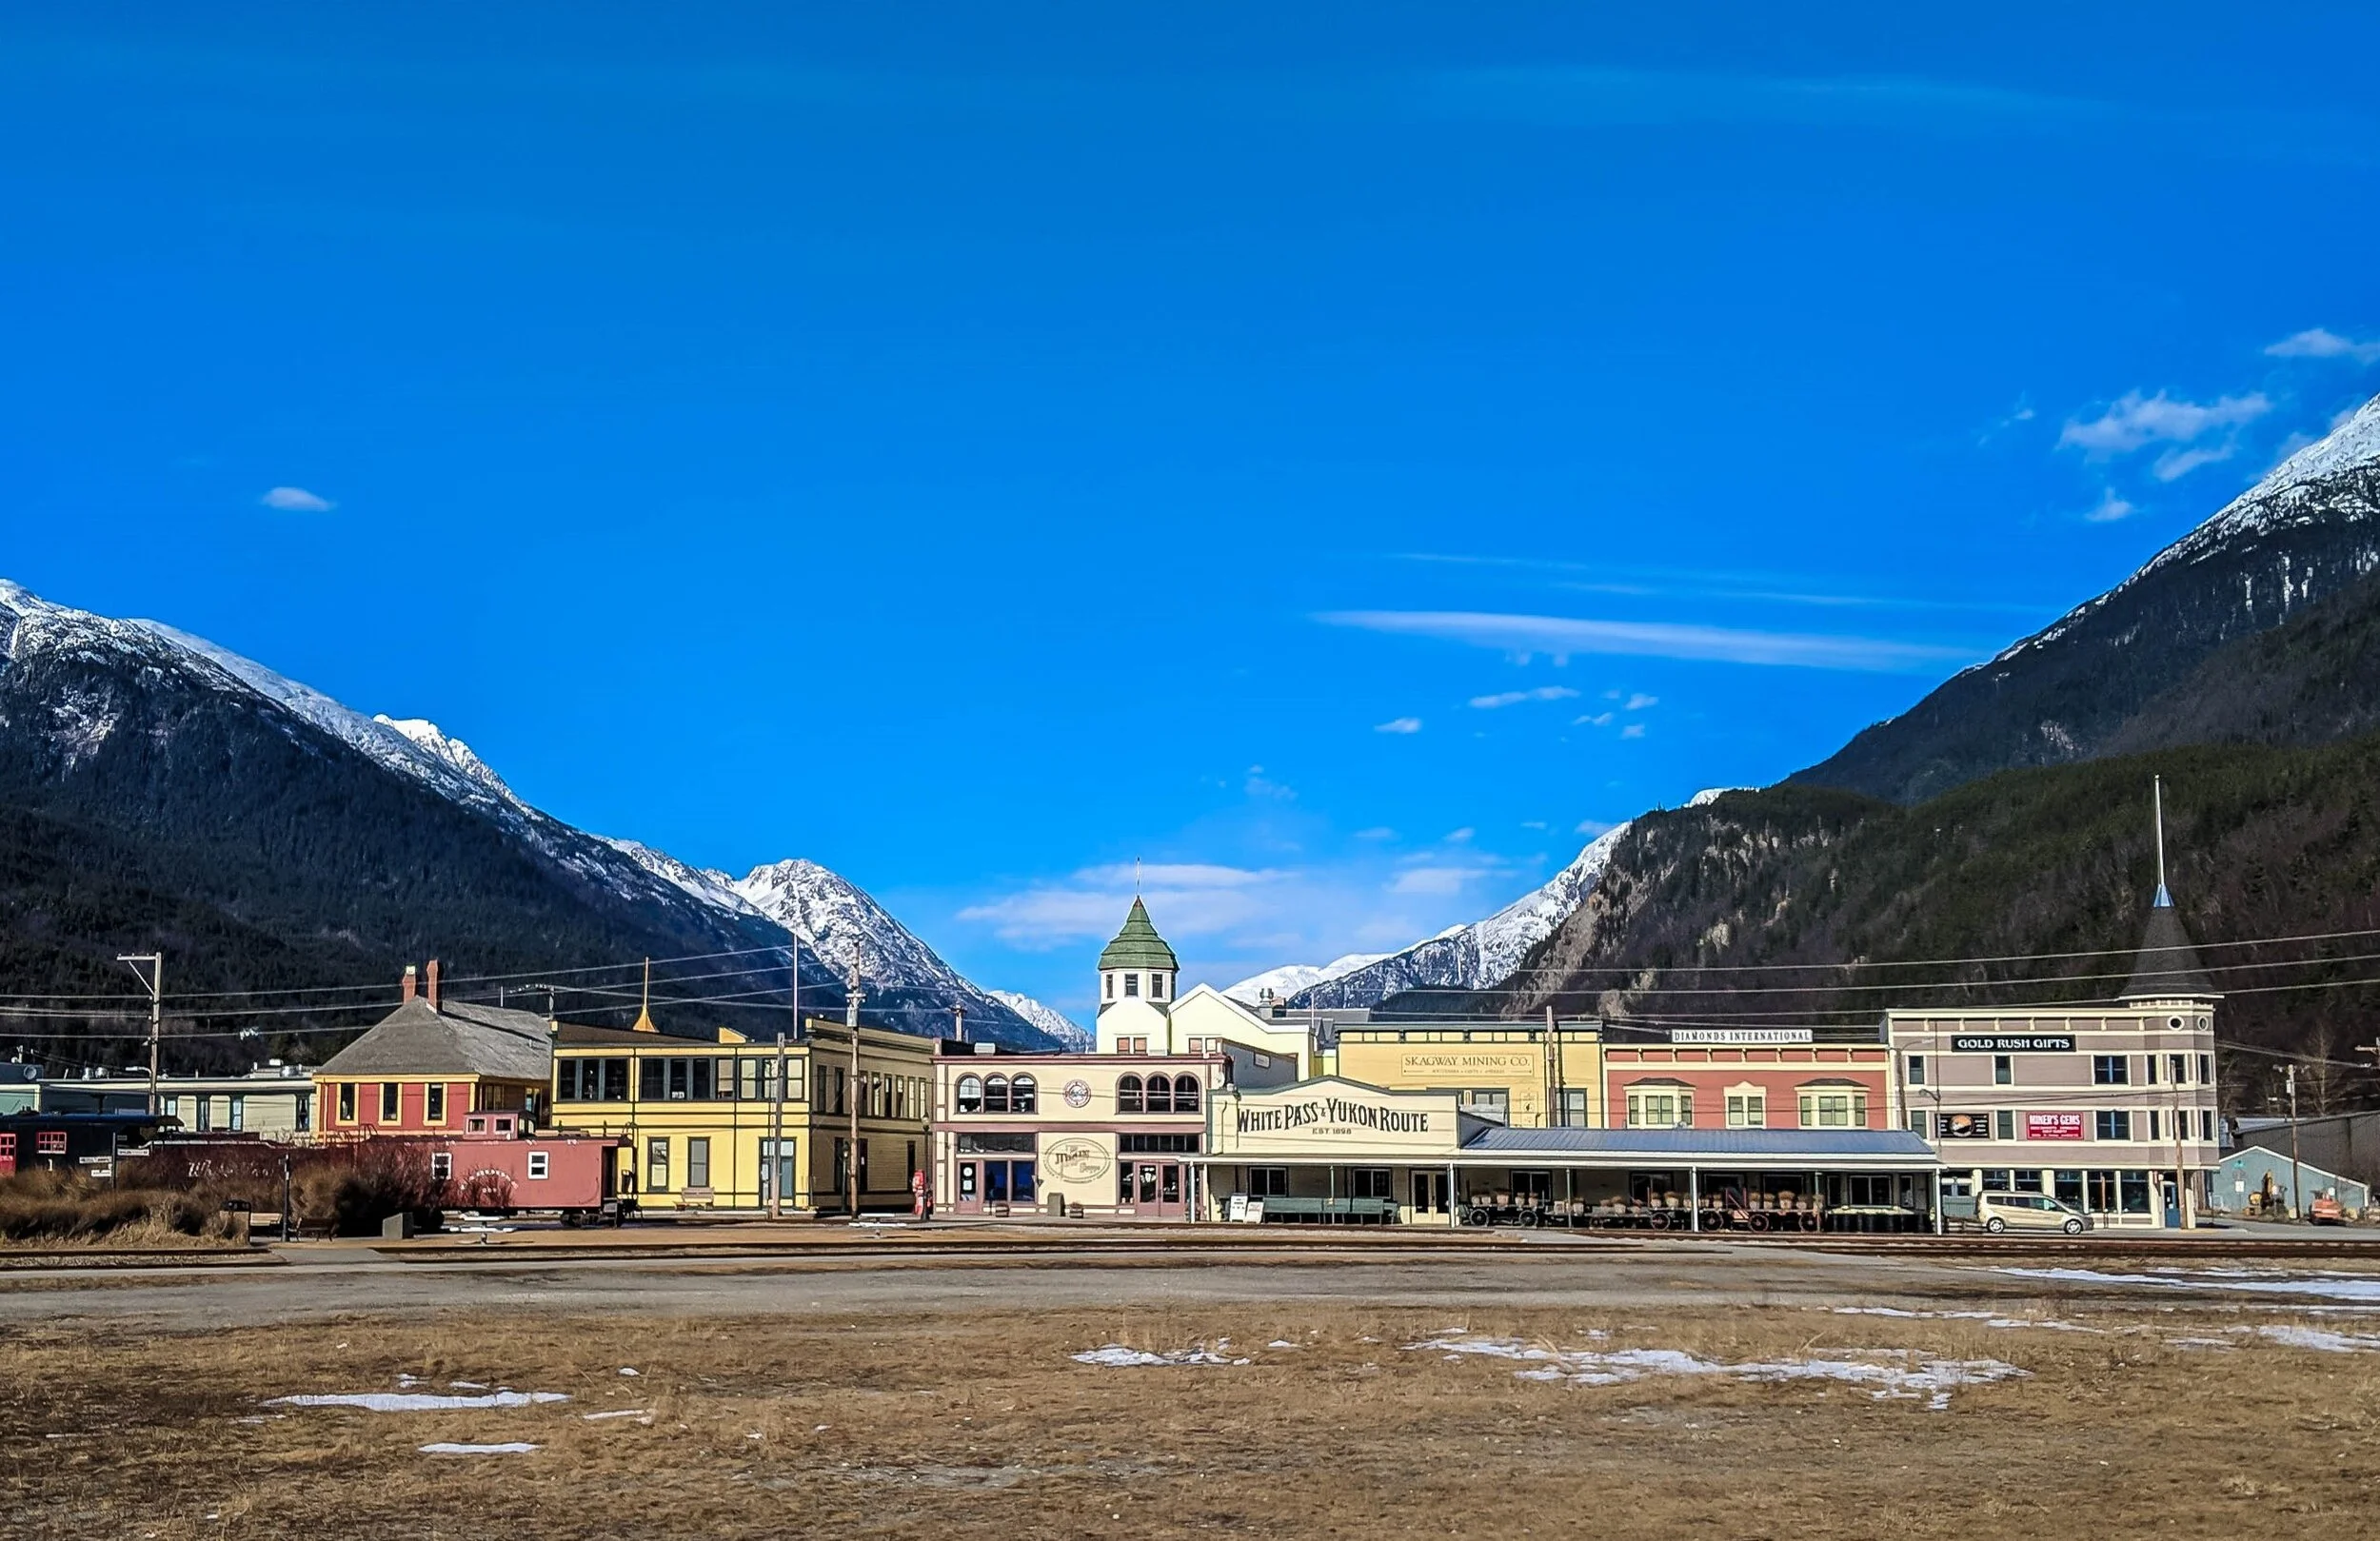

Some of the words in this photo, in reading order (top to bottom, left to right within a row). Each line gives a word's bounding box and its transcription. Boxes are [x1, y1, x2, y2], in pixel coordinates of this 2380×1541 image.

[1675, 1031, 1726, 1041] DIAMONDS
[1729, 1031, 1810, 1041] INTERNATIONAL
[1957, 1038, 1994, 1049] GOLD
[1996, 1038, 2031, 1049] RUSH
[2033, 1038, 2071, 1049] GIFTS
[1404, 1057, 1458, 1066] SKAGWAY
[1462, 1057, 1507, 1066] MINING
[1510, 1057, 1531, 1066] CO.
[1238, 1107, 1282, 1133] WHITE
[1284, 1101, 1319, 1130] PASS
[1325, 1097, 1378, 1129] YUKON
[1379, 1106, 1429, 1133] ROUTE
